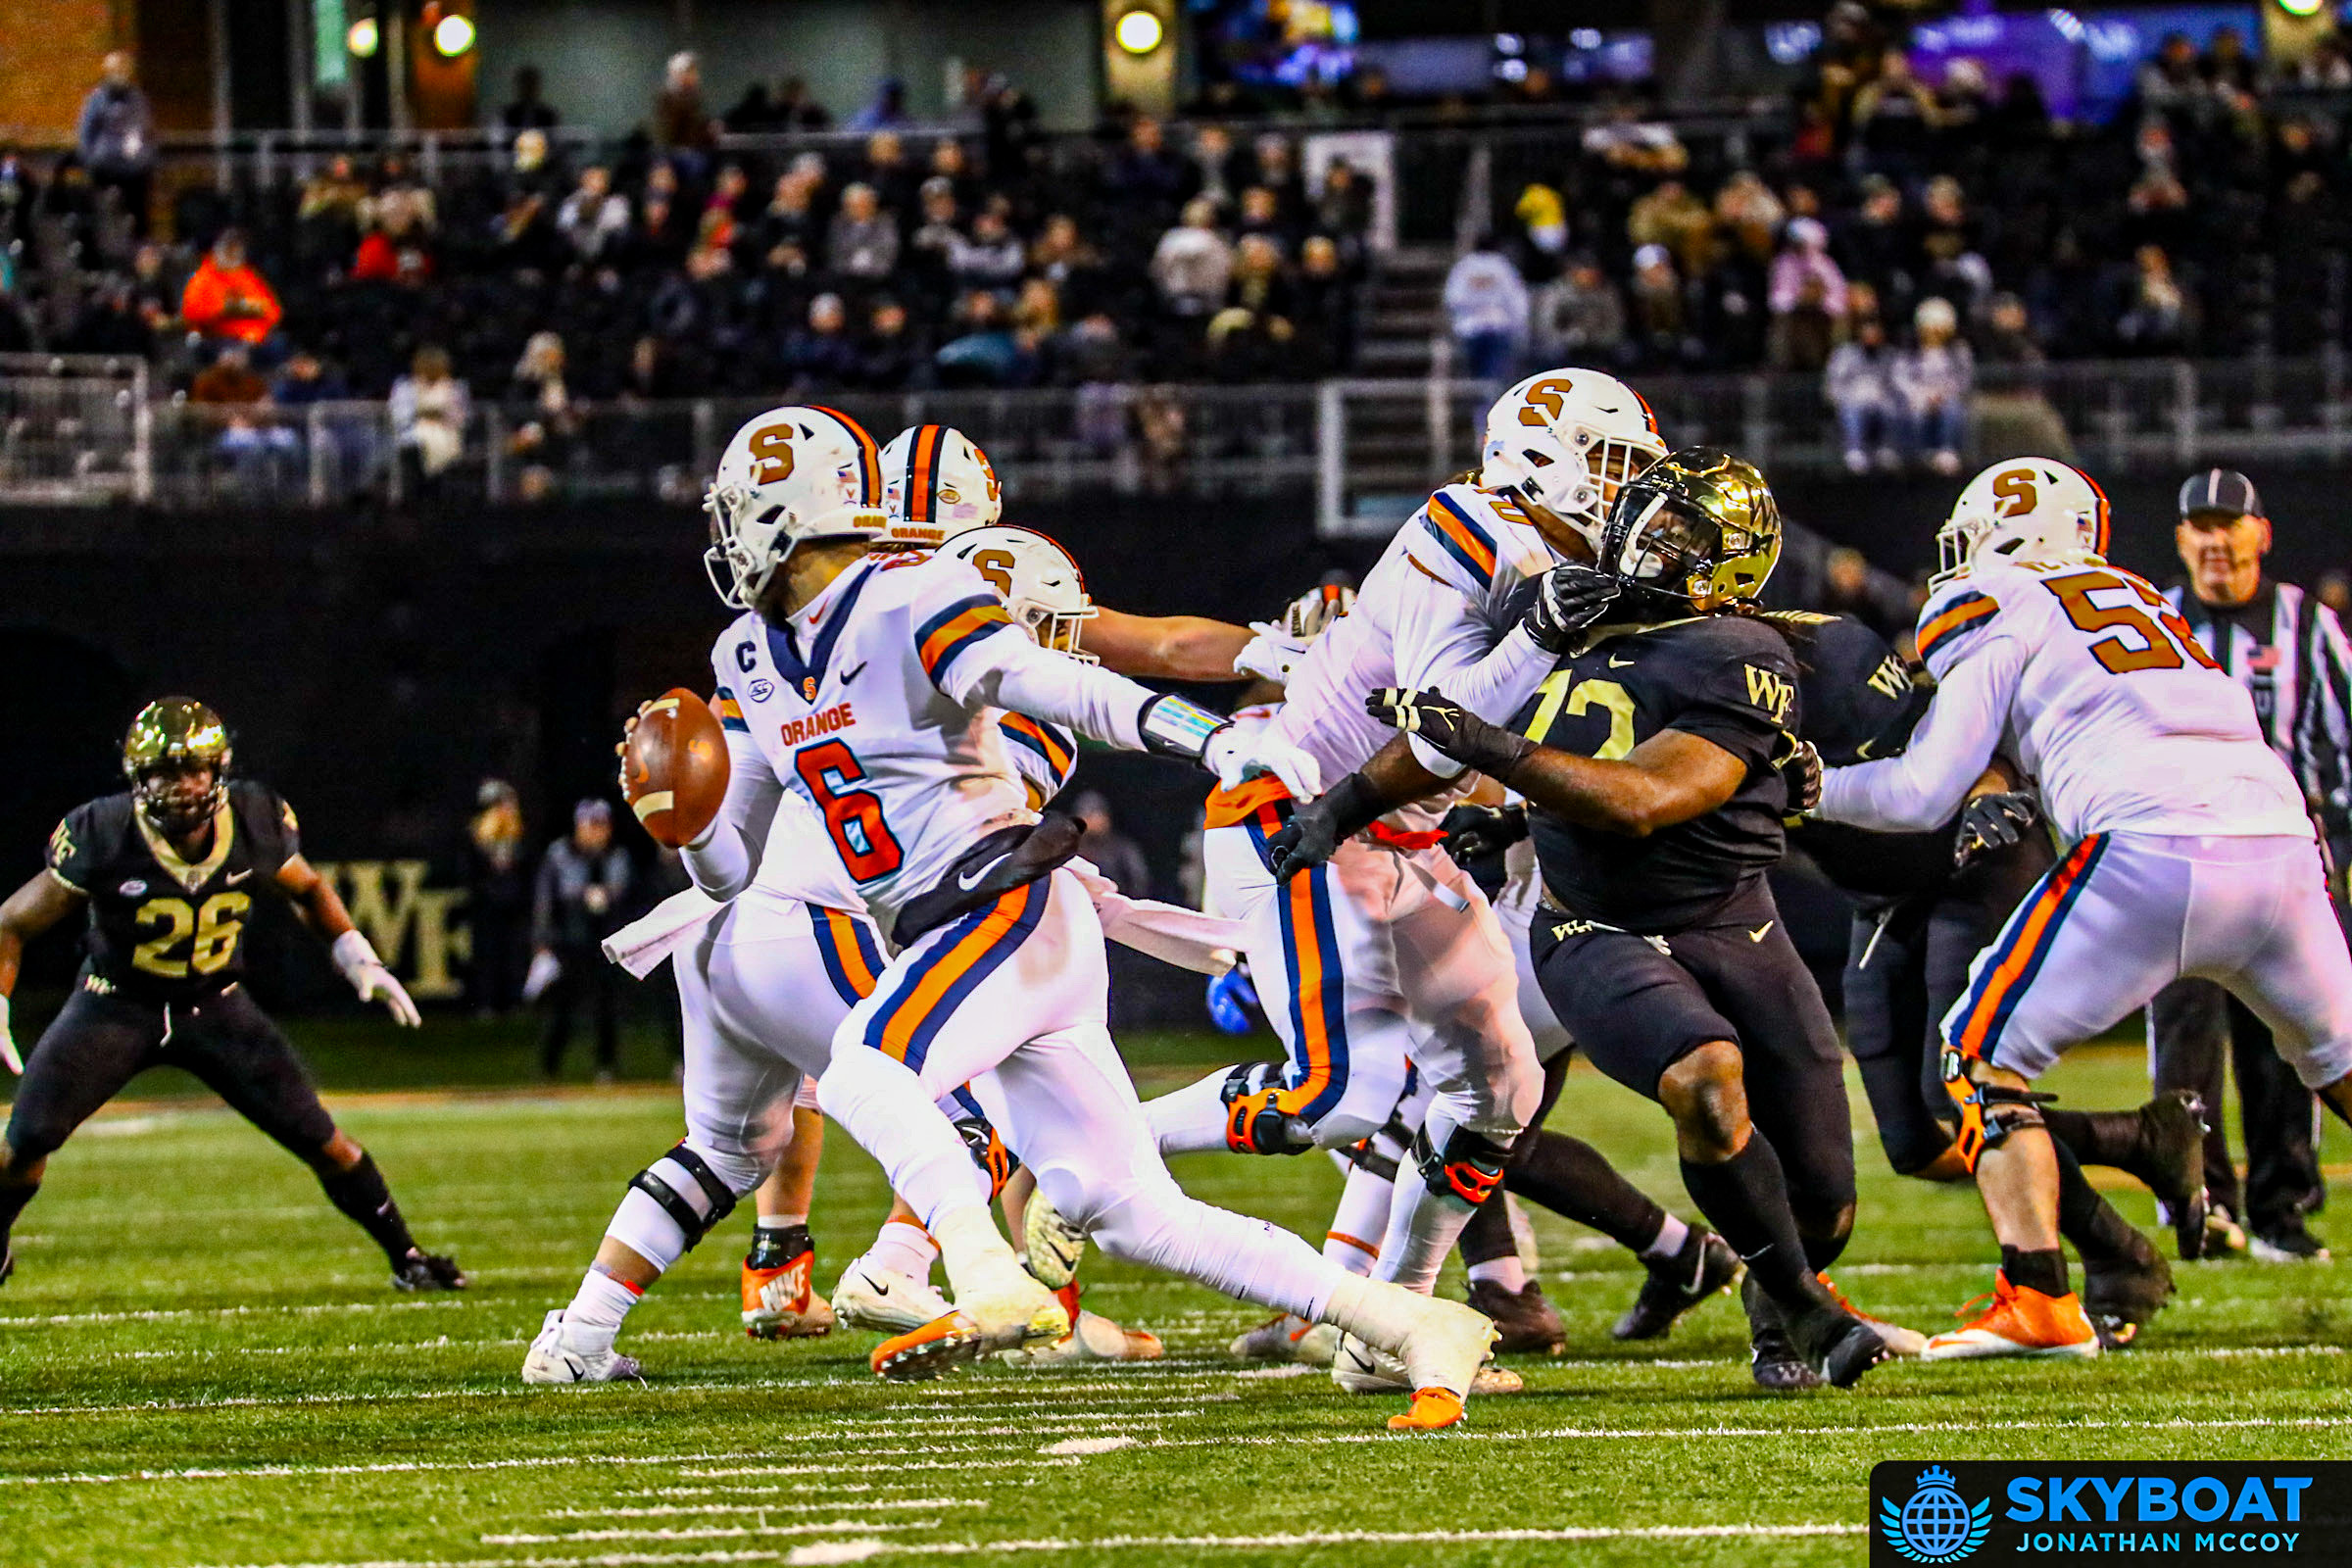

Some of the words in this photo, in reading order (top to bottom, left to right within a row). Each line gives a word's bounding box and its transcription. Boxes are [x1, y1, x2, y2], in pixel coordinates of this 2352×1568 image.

[1517, 377, 1574, 428] S
[748, 422, 795, 486] S
[1991, 467, 2038, 517] S
[891, 527, 946, 541] ORANGE
[735, 640, 758, 673] C
[803, 676, 817, 701] S
[1744, 663, 1794, 724] WF
[780, 702, 857, 747] ORANGE
[795, 737, 905, 885] 6
[132, 891, 253, 978] 26
[759, 1262, 806, 1313] NIKE
